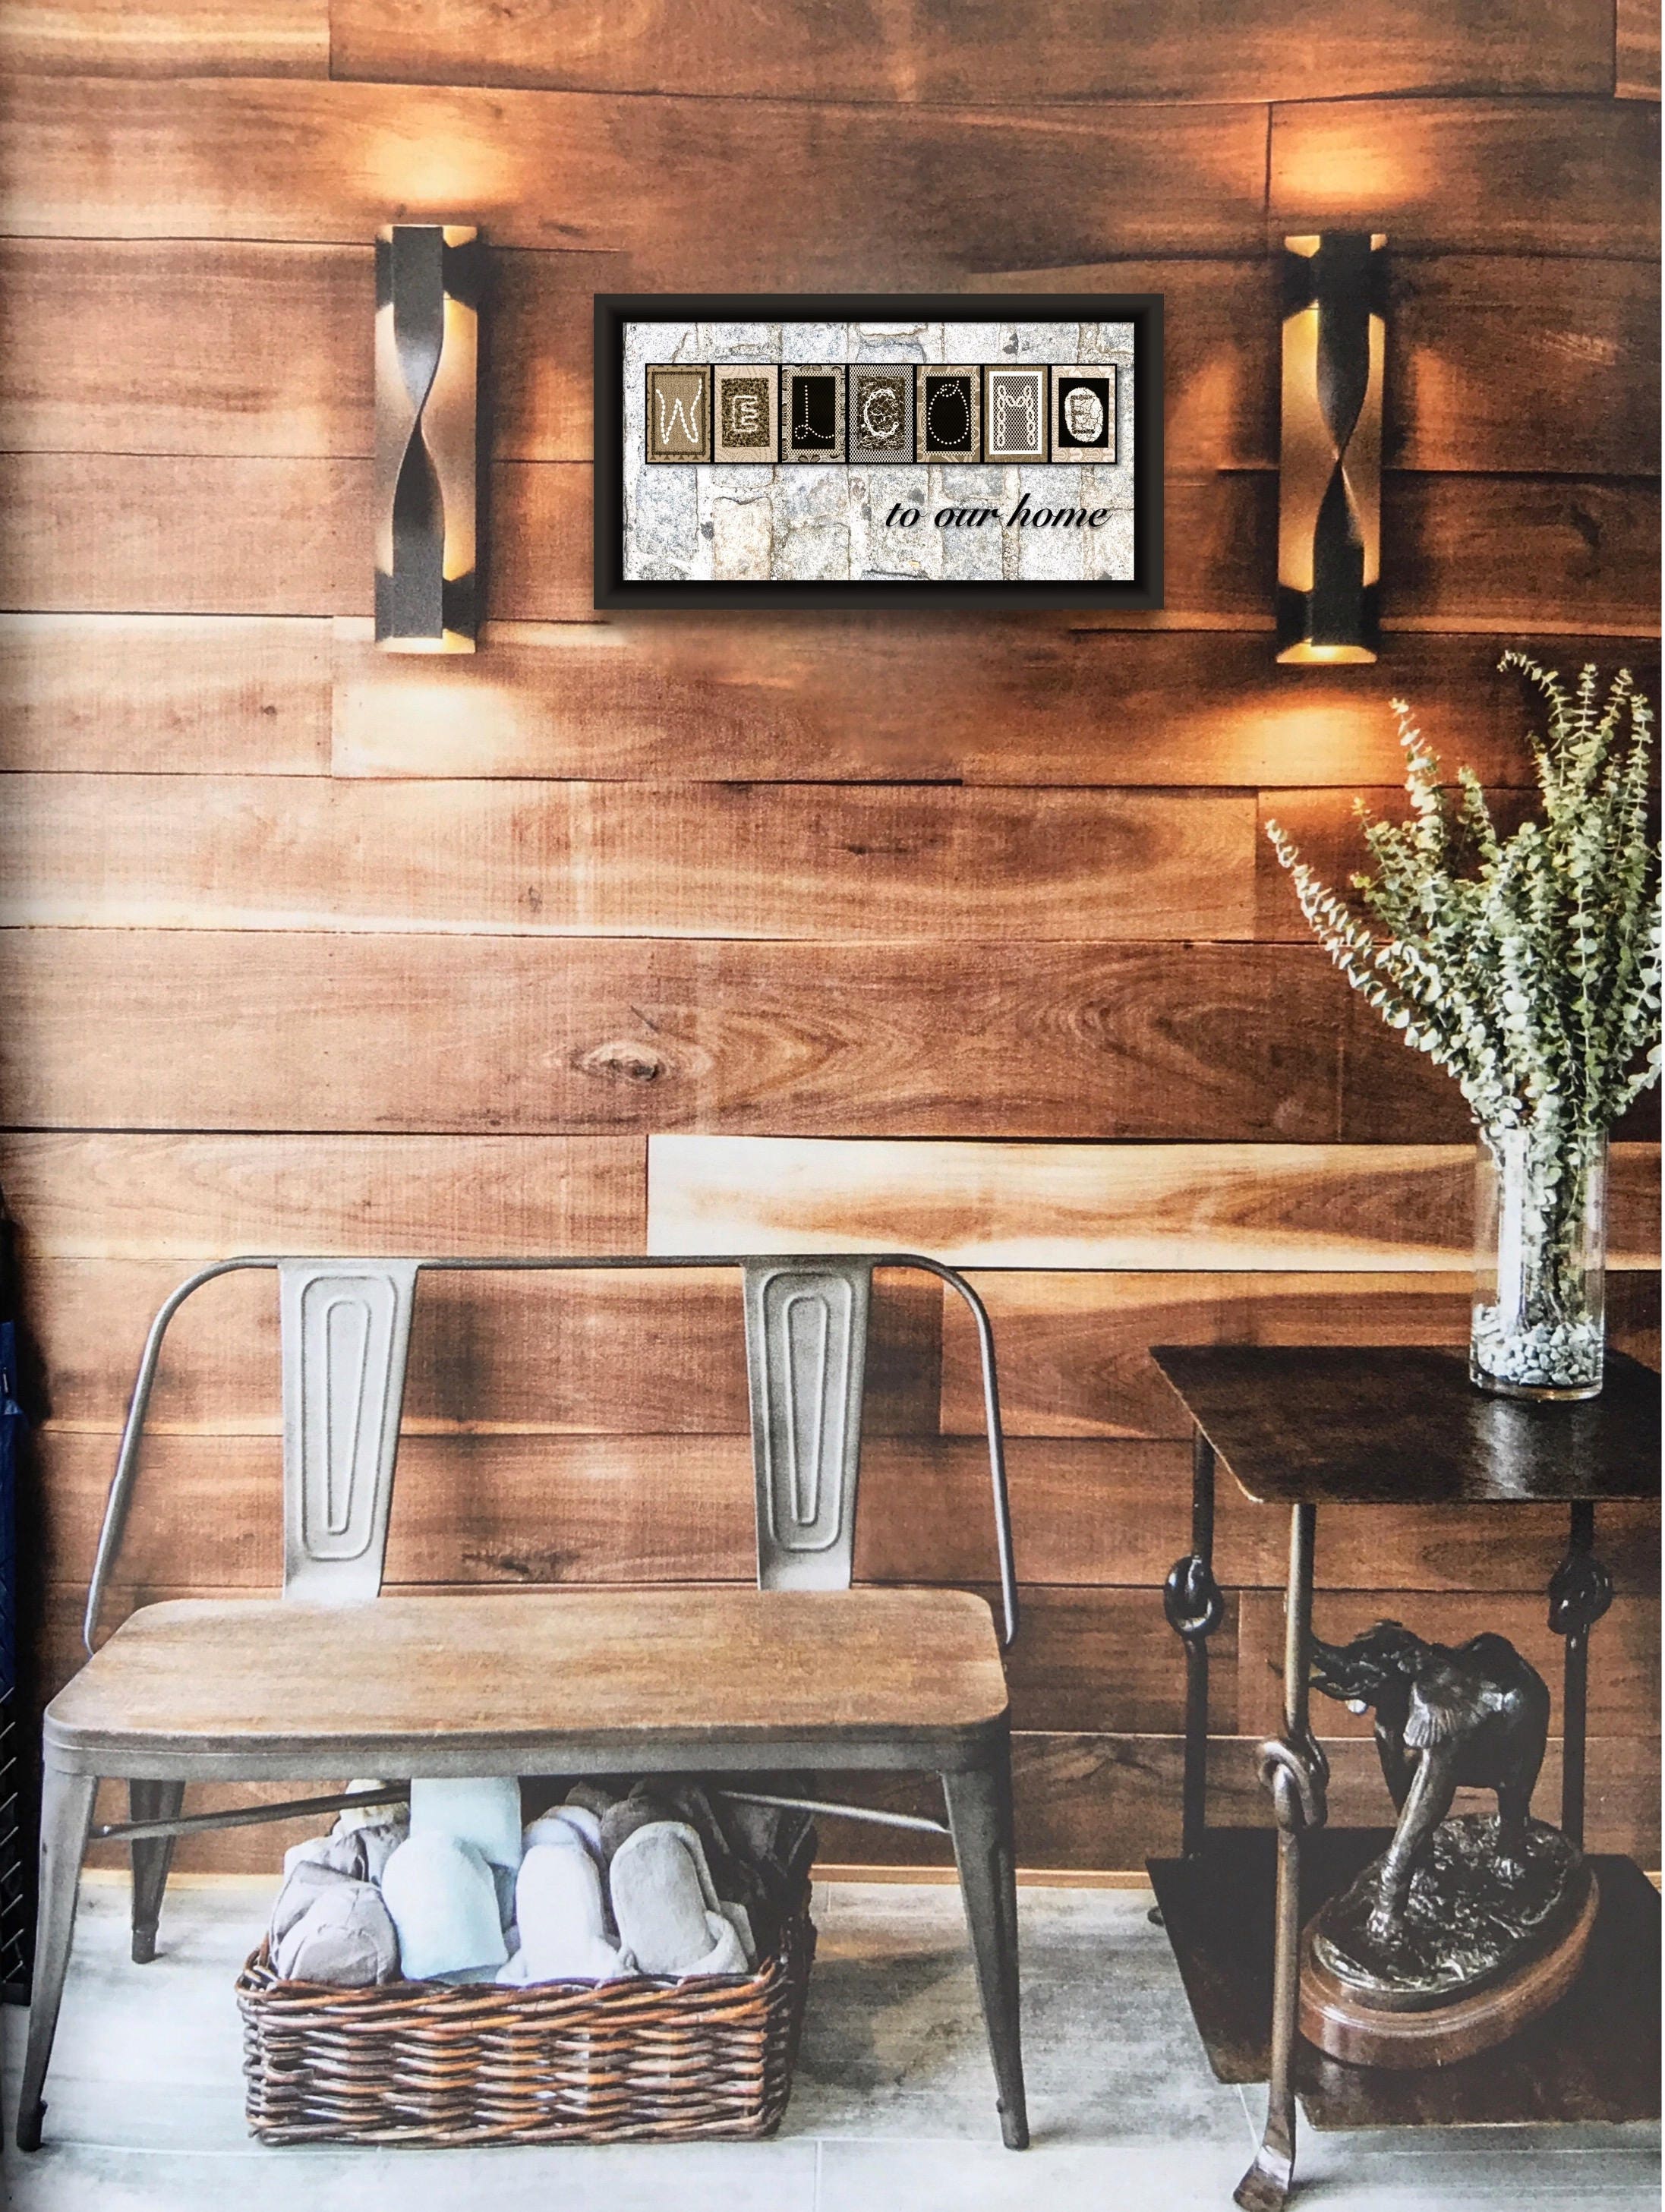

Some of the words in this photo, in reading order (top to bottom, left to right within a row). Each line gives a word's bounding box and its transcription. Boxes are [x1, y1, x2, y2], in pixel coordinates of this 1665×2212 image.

[654, 378, 1099, 446] WELCOME
[885, 502, 923, 528] to
[935, 507, 1004, 528] our
[1006, 493, 1113, 528] home
